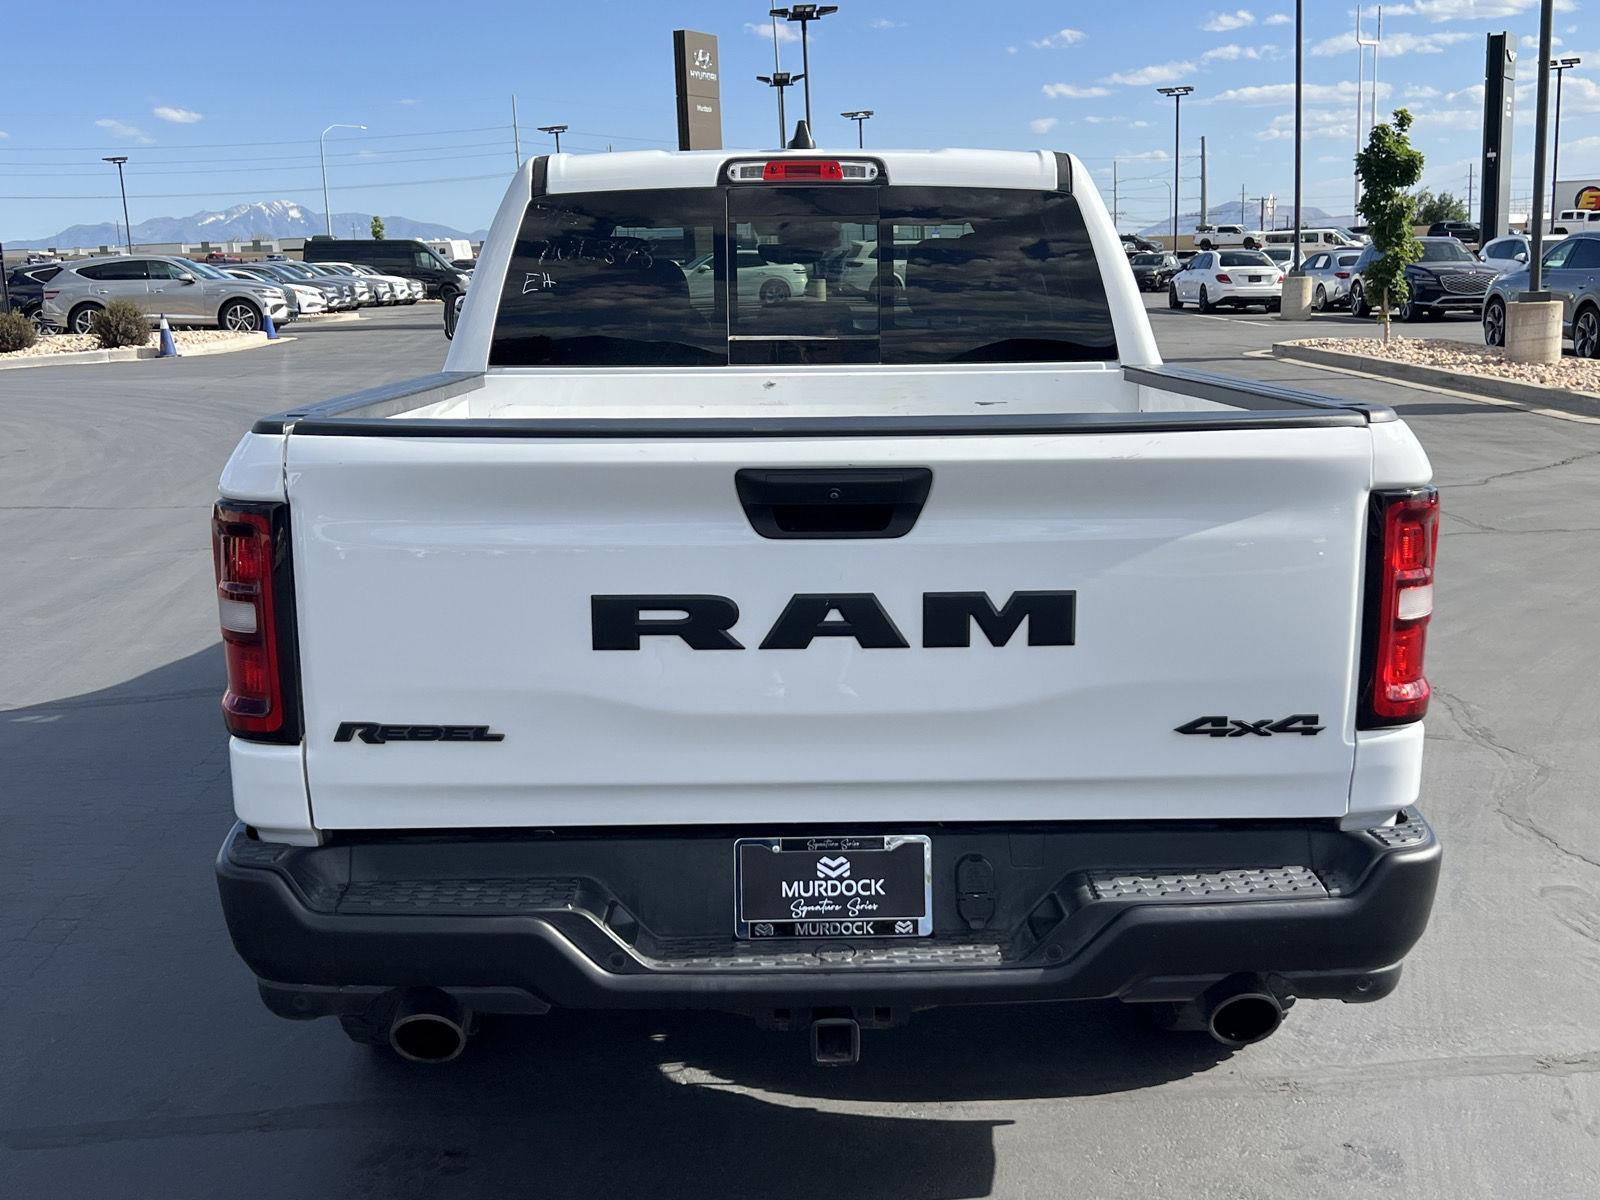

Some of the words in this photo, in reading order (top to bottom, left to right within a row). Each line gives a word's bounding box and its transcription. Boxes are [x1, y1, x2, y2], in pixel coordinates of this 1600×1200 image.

[689, 69, 718, 81] HYUNDAI
[591, 590, 1077, 650] RAM
[333, 721, 505, 744] REBEL
[806, 838, 839, 850] Signature
[840, 838, 860, 850] Series
[781, 878, 886, 898] MURDOCK
[790, 898, 842, 919] Signature
[846, 897, 879, 917] Series
[794, 921, 875, 936] MURDOCK
